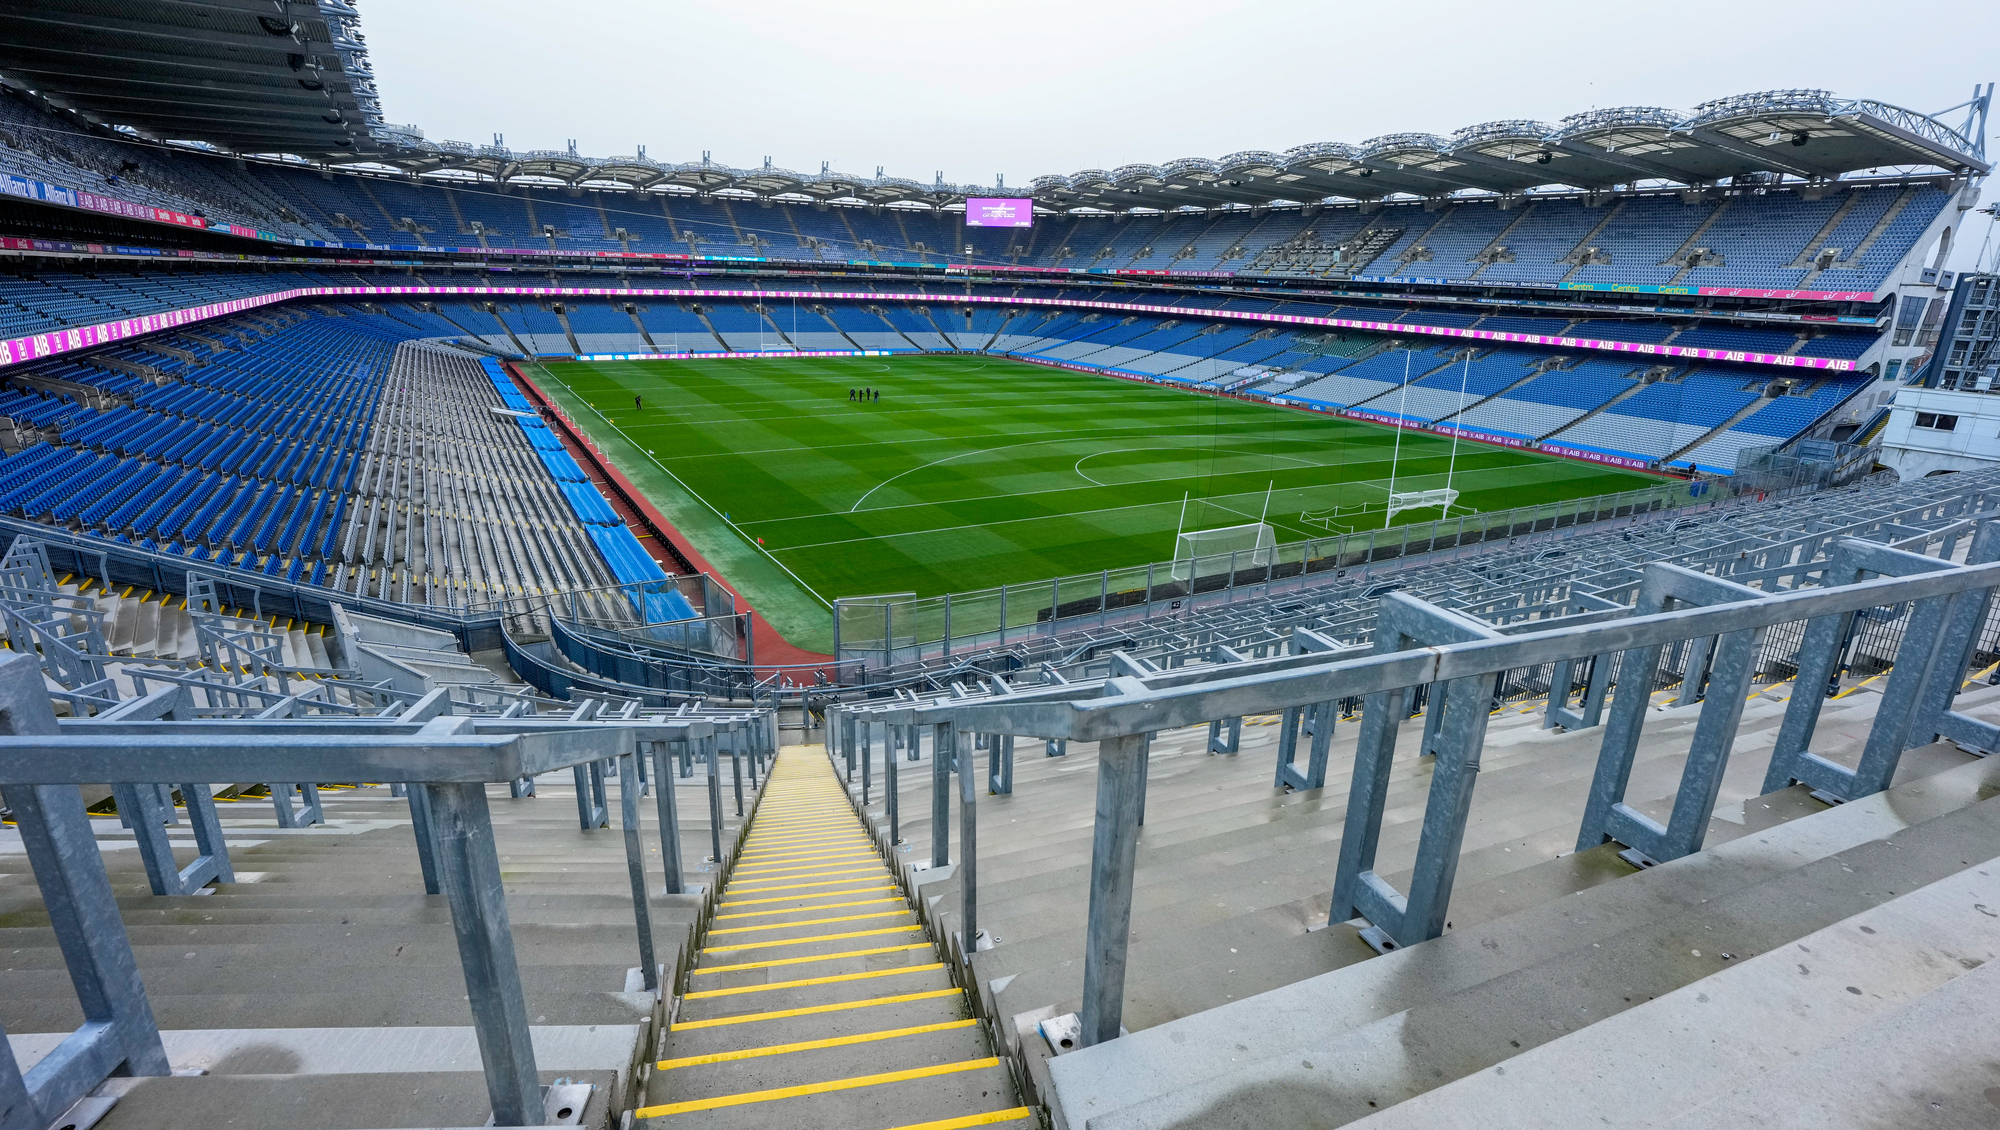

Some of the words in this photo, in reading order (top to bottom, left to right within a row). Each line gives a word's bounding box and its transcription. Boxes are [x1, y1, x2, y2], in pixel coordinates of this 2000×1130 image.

[1568, 282, 1594, 290] Centra
[1611, 284, 1639, 292] Centra
[1658, 286, 1689, 294] Centra
[1729, 288, 1742, 296] eir
[1763, 290, 1777, 298] eir
[1786, 290, 1800, 298] eir
[1823, 292, 1838, 300] eir
[1845, 292, 1860, 300] eir
[121, 321, 132, 337] AIB
[1431, 327, 1444, 335] AIB
[97, 325, 109, 343] AIB
[1492, 332, 1506, 340] AIB
[67, 329, 82, 349] AIB
[1525, 335, 1540, 343] AIB
[1560, 338, 1576, 346] AIB
[34, 335, 50, 357] AIB
[1597, 341, 1614, 350] AIB
[1637, 344, 1655, 353] AIB
[0, 342, 12, 365] IB
[1679, 348, 1698, 357] AIB
[1724, 352, 1745, 361] AIB
[1773, 355, 1795, 365] AIB
[1825, 360, 1849, 370] AIB
